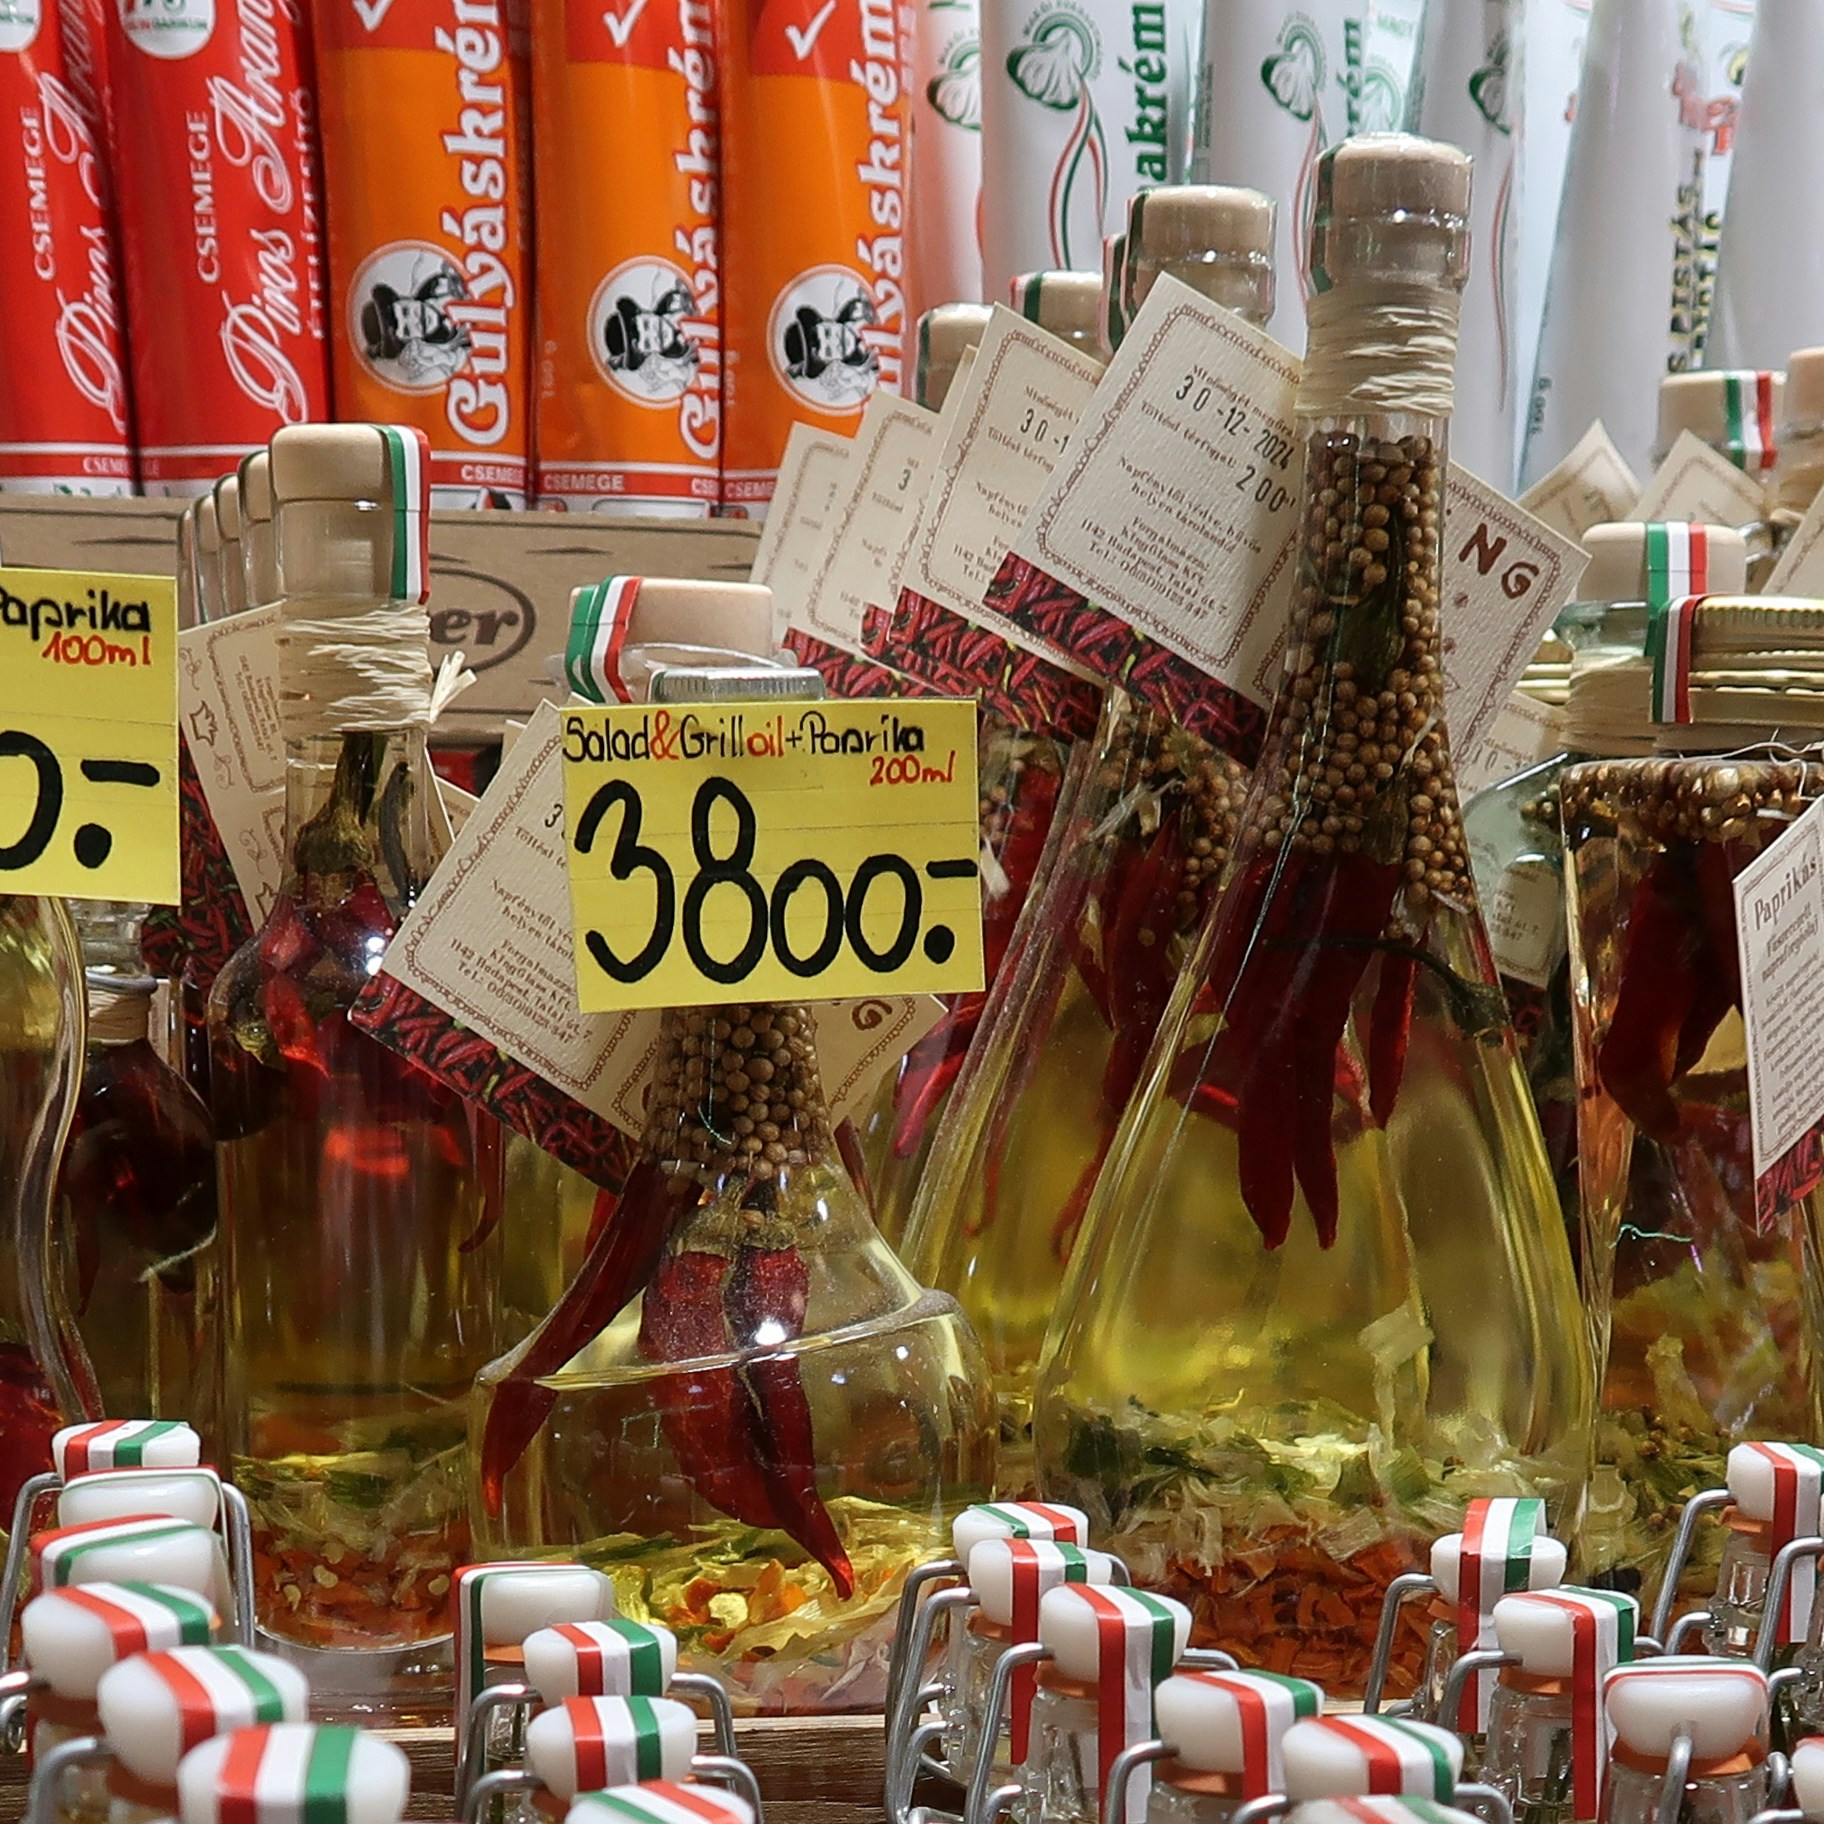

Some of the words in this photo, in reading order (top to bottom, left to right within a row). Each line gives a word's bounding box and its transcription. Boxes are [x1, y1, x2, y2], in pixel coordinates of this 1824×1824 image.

[1117, 0, 1168, 191] akrém
[20, 106, 57, 281] CSEMEGE
[185, 110, 221, 283] CSEMEGE
[435, 0, 517, 446] Gulyáskré
[850, 0, 903, 410] ulyáskrém
[542, 472, 625, 492] CSEMEGE
[42, 631, 152, 667] 100ml
[563, 714, 651, 762] Salad
[869, 750, 957, 786] 200ml
